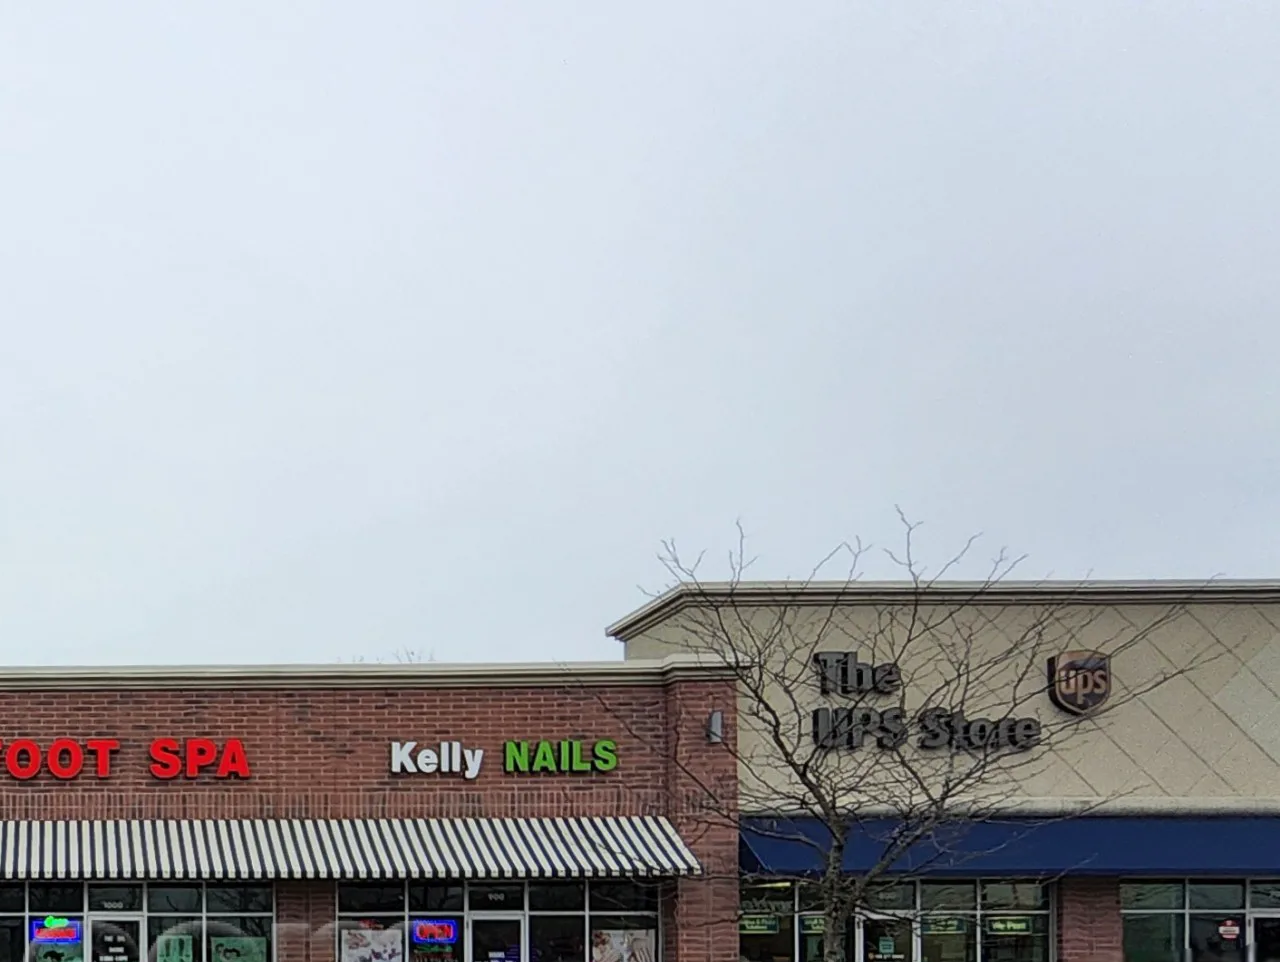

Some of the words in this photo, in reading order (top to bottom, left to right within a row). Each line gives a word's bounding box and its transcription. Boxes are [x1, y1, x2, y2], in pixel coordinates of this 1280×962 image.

[812, 650, 902, 695] The
[1059, 667, 1108, 705] ups
[812, 706, 908, 750] UPS
[918, 706, 1042, 750] Store
[149, 738, 251, 780] SPA
[391, 741, 484, 779] Kelly
[505, 740, 618, 774] NAILS
